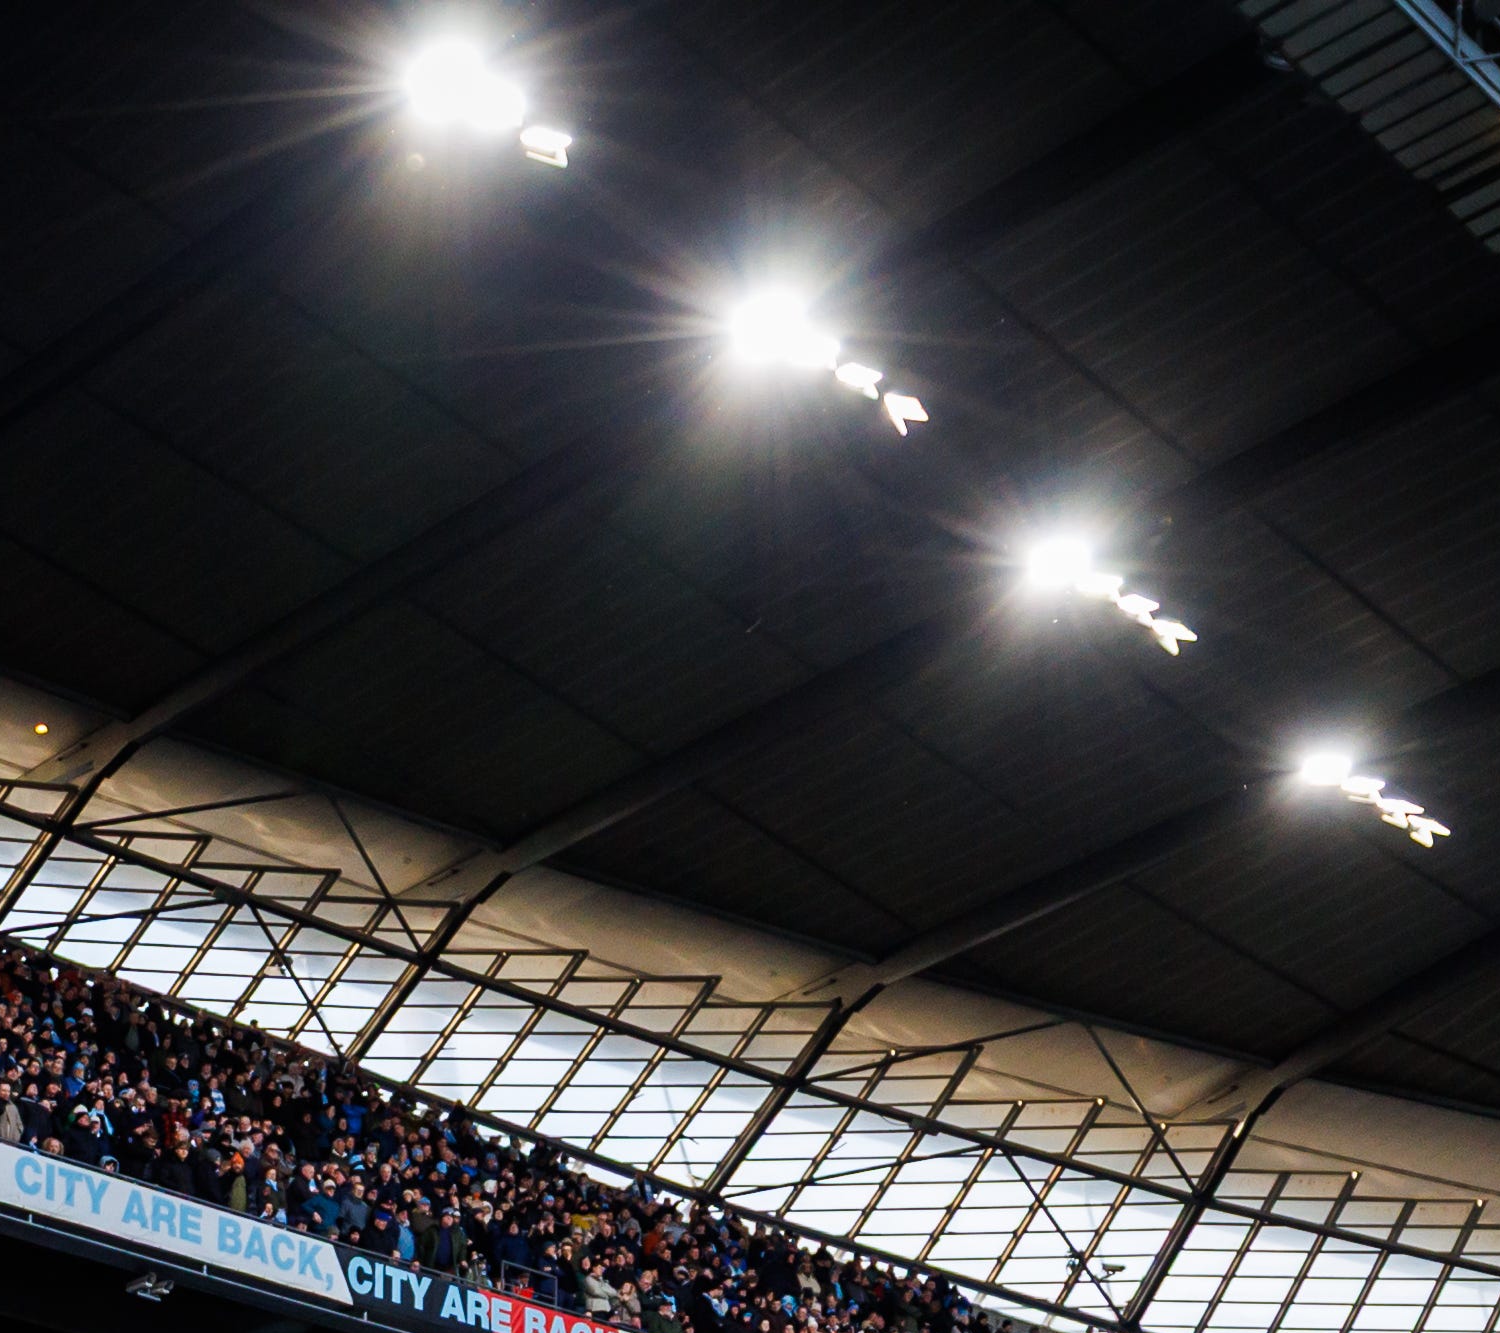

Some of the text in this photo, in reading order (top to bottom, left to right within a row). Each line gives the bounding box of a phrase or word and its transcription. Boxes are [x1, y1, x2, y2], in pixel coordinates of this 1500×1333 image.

[14, 1156, 334, 1291] CITY ARE BACK,
[348, 1256, 432, 1311] CITY
